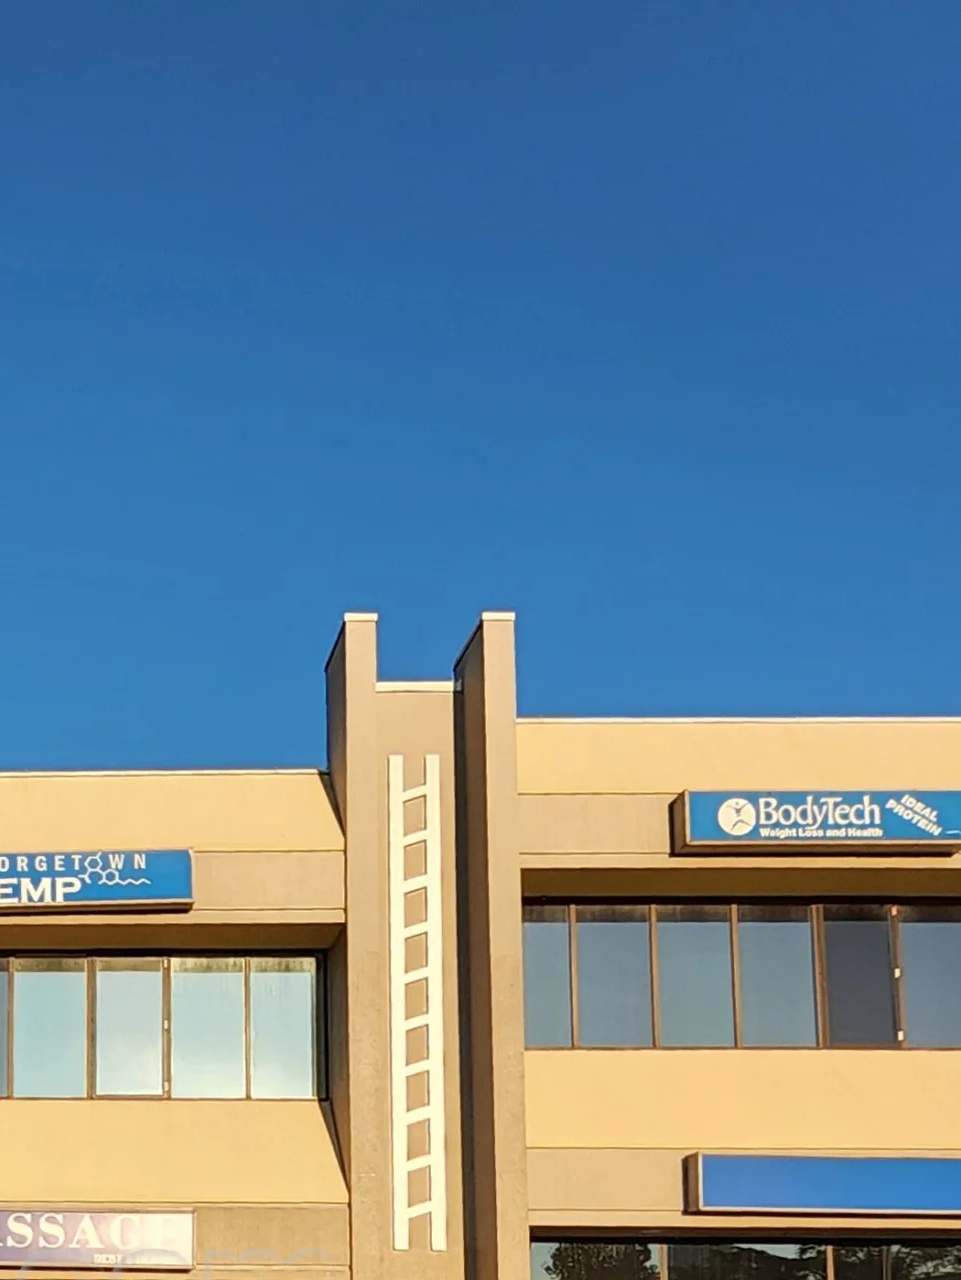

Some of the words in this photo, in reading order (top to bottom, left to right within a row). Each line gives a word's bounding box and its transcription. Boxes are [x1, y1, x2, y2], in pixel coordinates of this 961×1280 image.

[758, 795, 881, 829] BodyTech
[885, 799, 943, 837] PROTEIN
[900, 794, 939, 822] IDEAL
[759, 827, 798, 839] Weight
[825, 828, 846, 837] and
[847, 828, 883, 837] Health
